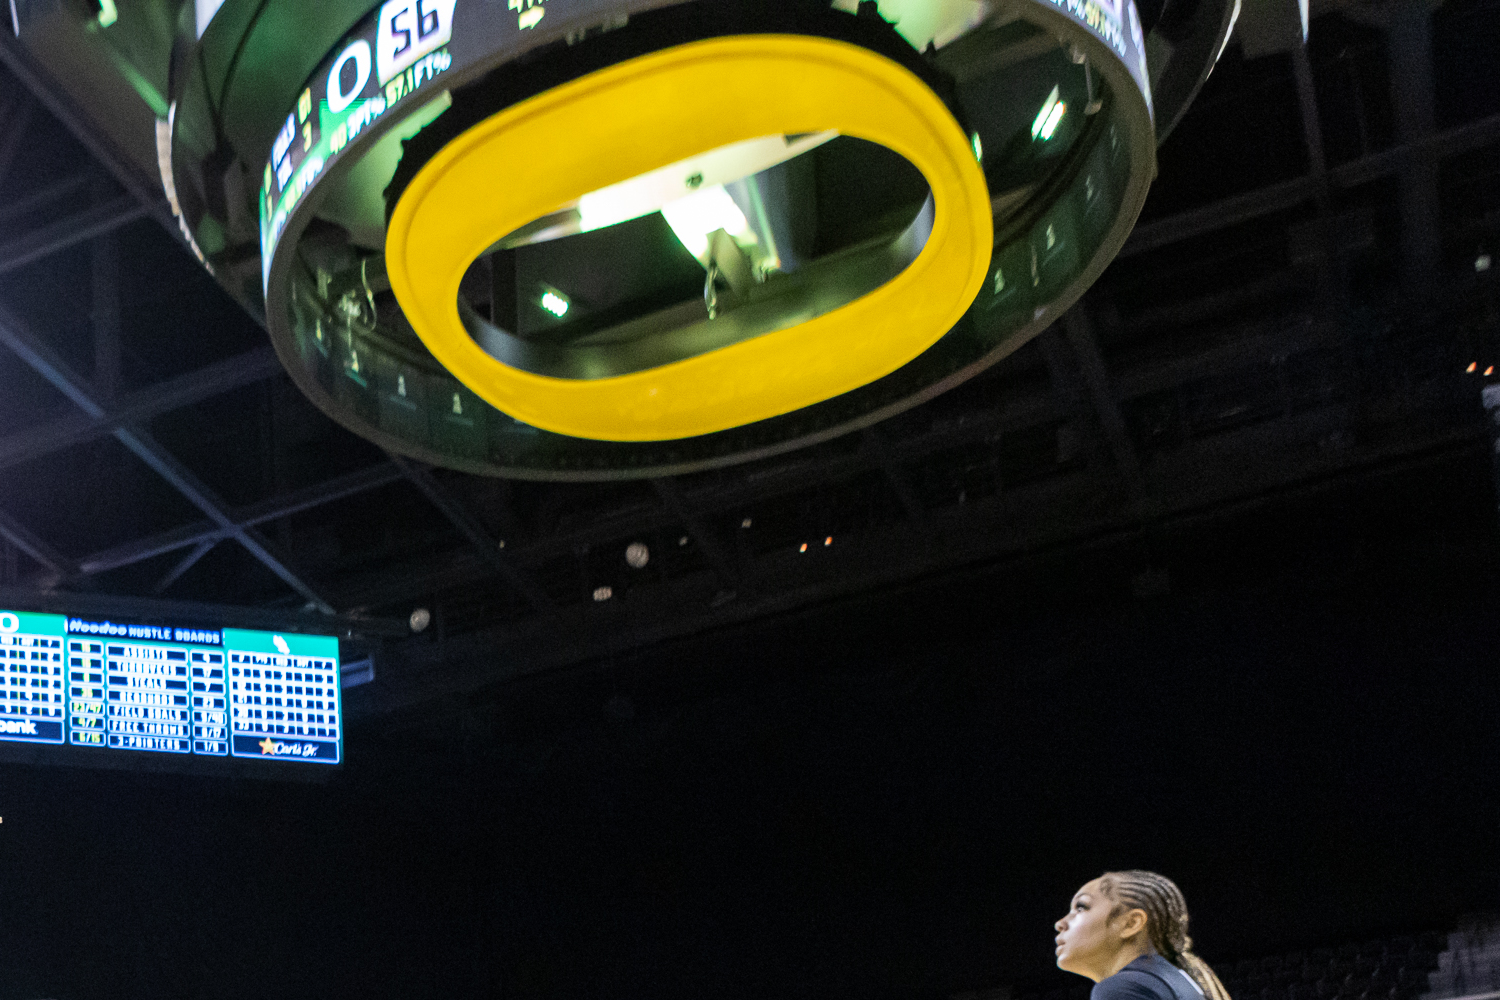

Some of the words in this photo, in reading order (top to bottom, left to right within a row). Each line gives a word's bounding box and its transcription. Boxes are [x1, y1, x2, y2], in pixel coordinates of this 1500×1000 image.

[390, 0, 439, 59] 56
[128, 625, 172, 640] HUSTLE
[174, 628, 220, 644] BOARDS
